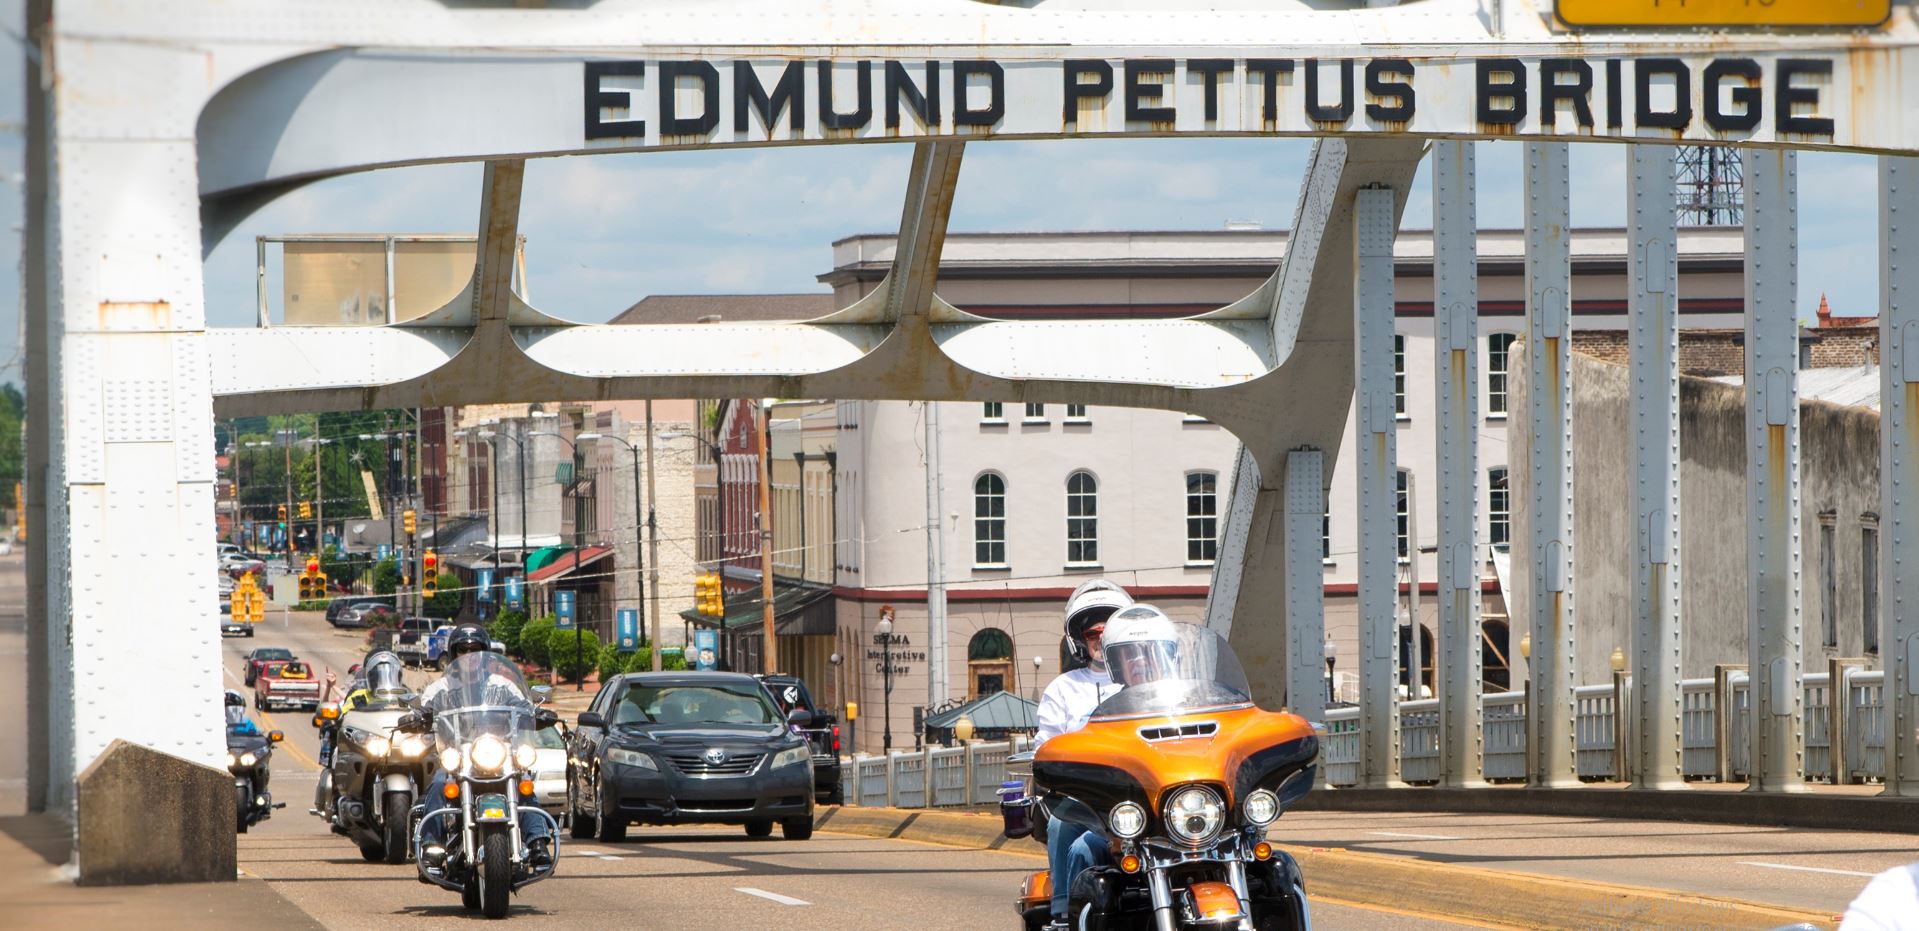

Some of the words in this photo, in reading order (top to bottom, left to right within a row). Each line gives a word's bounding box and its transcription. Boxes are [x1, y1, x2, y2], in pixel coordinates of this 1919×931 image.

[584, 60, 1004, 140] EDMUND
[1063, 58, 1416, 129] PETTUS
[1475, 58, 1835, 137] BRIDGE
[873, 634, 910, 645] SEMA
[867, 649, 925, 661] Interretive
[875, 663, 910, 673] Ceter
